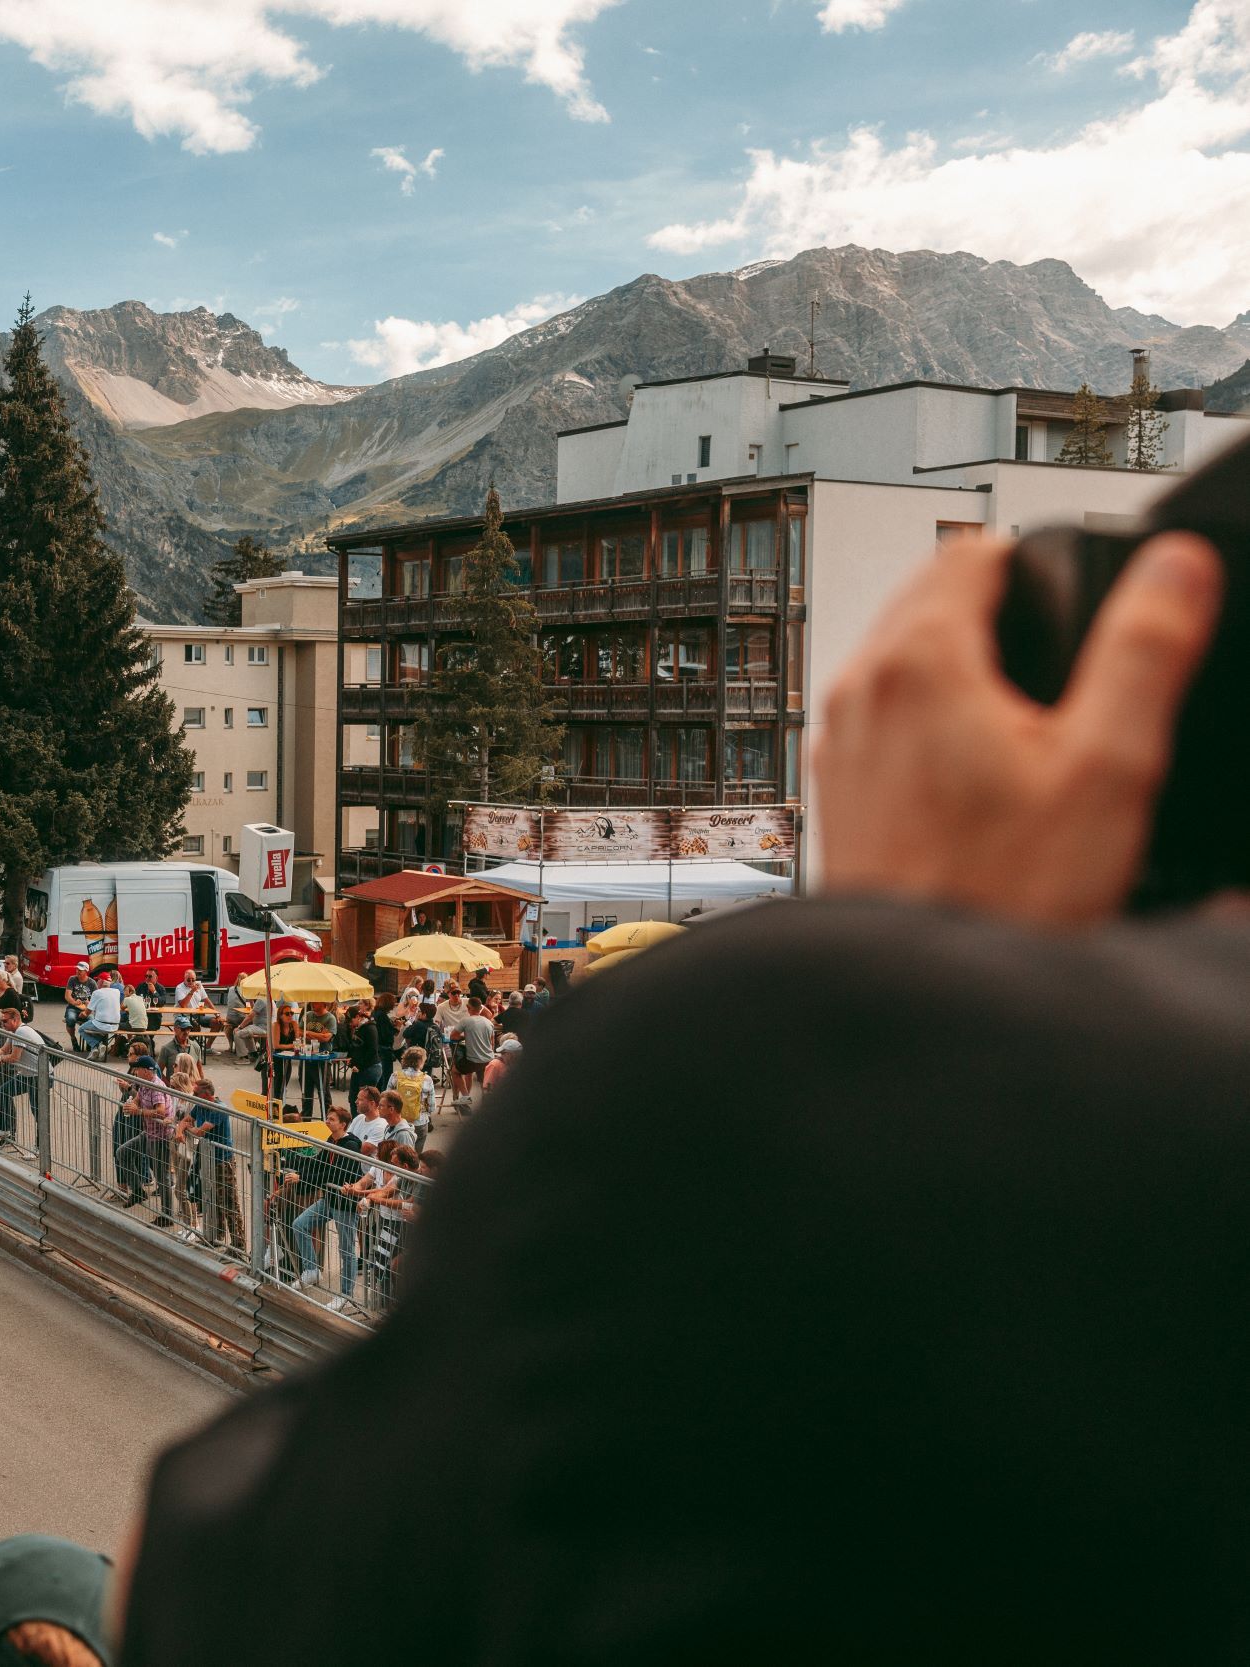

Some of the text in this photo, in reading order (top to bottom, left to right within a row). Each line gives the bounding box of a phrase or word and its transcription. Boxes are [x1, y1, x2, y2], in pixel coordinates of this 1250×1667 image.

[709, 814, 756, 827] Dessert
[272, 852, 283, 886] rivella
[104, 943, 118, 954] rive
